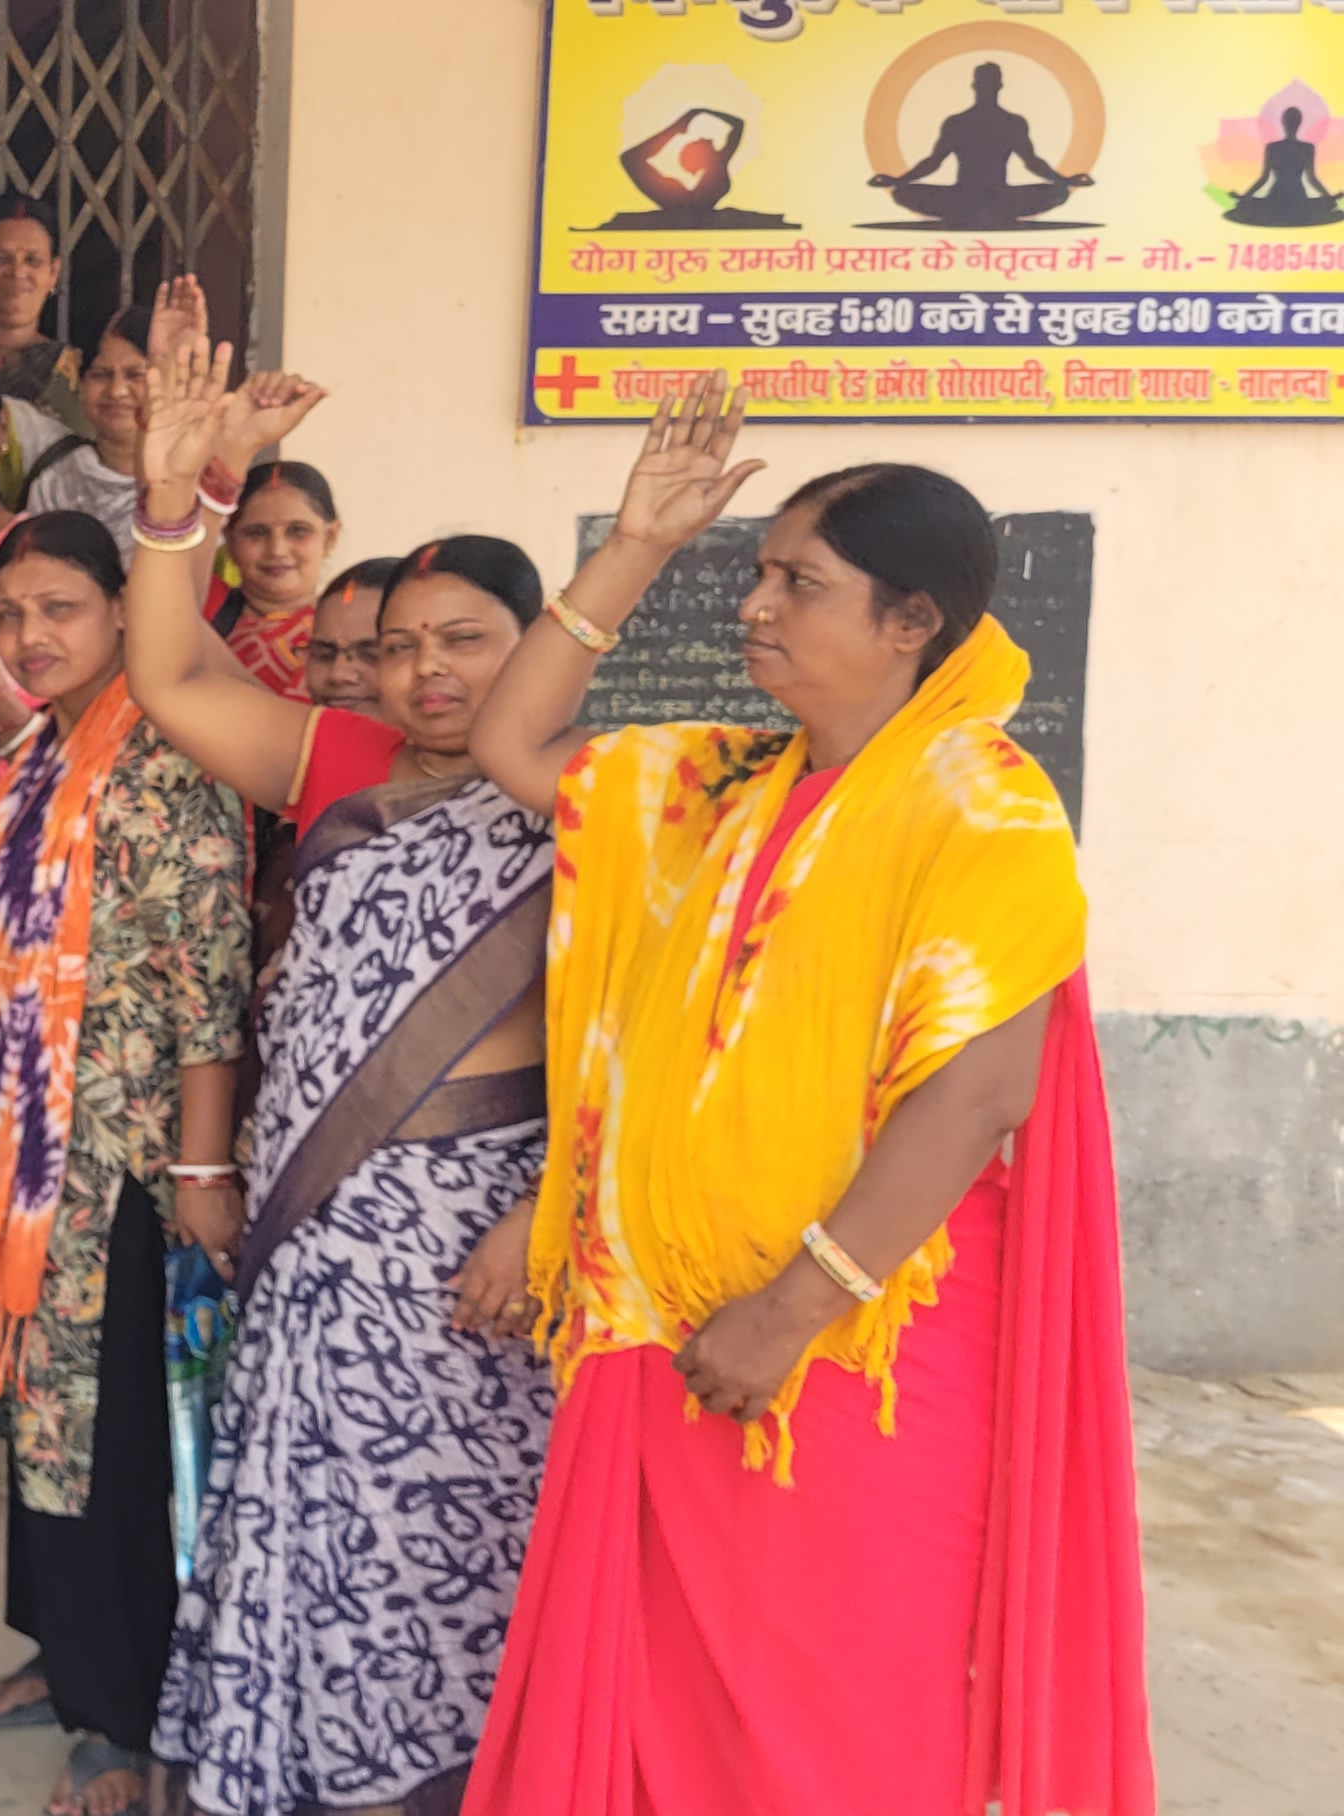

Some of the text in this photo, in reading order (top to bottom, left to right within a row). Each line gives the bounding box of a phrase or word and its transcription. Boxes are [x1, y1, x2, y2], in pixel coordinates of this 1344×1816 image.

[571, 241, 636, 273] योग
[646, 247, 708, 283] गुरू
[720, 239, 818, 273] रामजी
[825, 247, 915, 275] प्रसाद
[921, 239, 956, 273] के
[966, 239, 1060, 281] नेतृत्व
[1067, 238, 1099, 272] में
[599, 302, 704, 336] समय
[740, 302, 837, 346] सुबह
[839, 297, 913, 333] 5:30
[920, 293, 989, 335] बजे
[993, 293, 1035, 335] से
[1039, 302, 1136, 346] सुबह
[1137, 297, 1212, 333] 6:30
[1216, 293, 1288, 335] बजे
[834, 358, 869, 400] रेड
[1064, 359, 1133, 400] जिला
[1138, 367, 1213, 400] शाखा
[1238, 368, 1329, 400] नालन्दा
